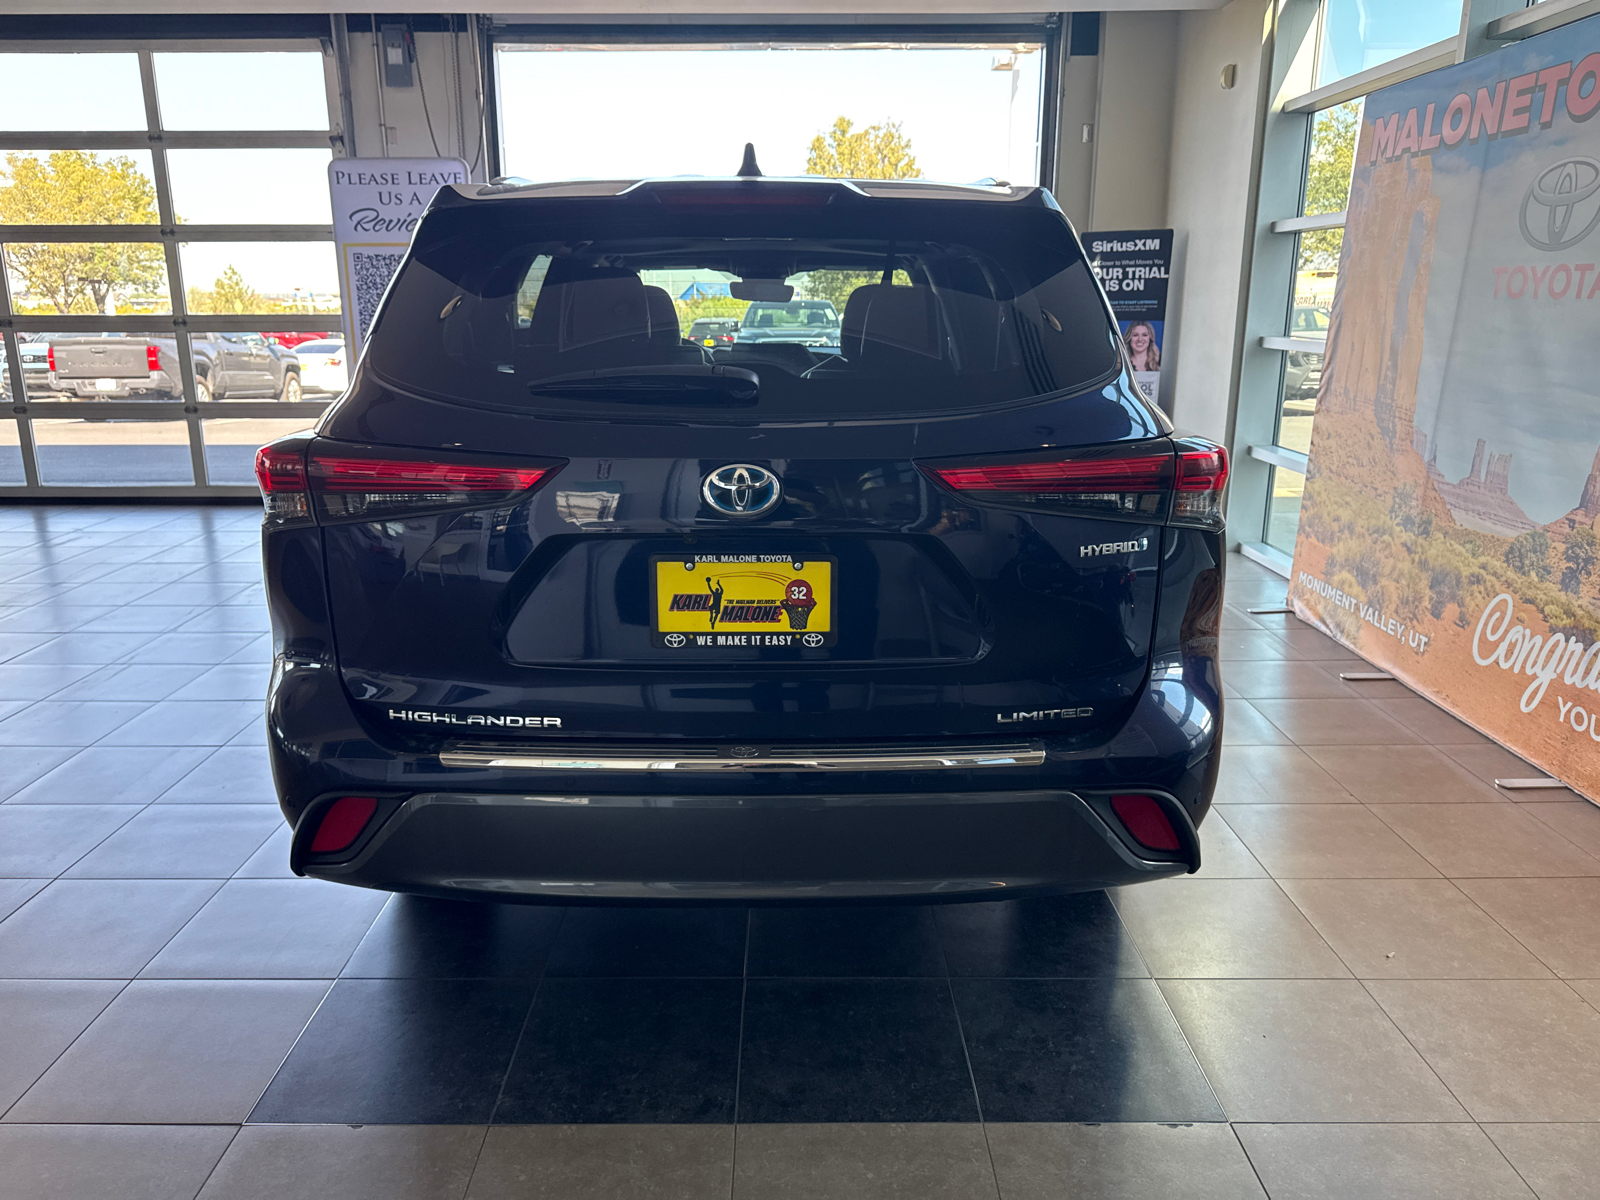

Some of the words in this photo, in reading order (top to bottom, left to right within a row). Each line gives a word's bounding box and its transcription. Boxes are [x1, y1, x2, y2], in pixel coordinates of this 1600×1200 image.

[334, 170, 400, 185] PLEASE
[406, 170, 463, 185] LEAVE
[377, 191, 403, 205] US
[408, 191, 423, 205] A
[348, 207, 419, 233] Revie
[1092, 239, 1160, 252] SiriusXM
[1093, 267, 1123, 280] OUR
[1126, 266, 1169, 279] TRIAL
[1105, 280, 1119, 292] IS
[1122, 279, 1144, 291] ON
[1080, 541, 1140, 557] HYBRID
[694, 555, 720, 563] KARL
[760, 554, 792, 562] TOYOTA
[790, 586, 807, 600] 32
[669, 594, 712, 612] KARL
[718, 604, 783, 623] MALONE
[1299, 570, 1358, 613] MONUMENT
[1358, 603, 1406, 645] VALLEY,
[1408, 632, 1429, 653] UT
[696, 635, 713, 646] WE
[717, 635, 748, 646] MAKE
[752, 635, 761, 646] IT
[765, 635, 792, 646] EASY
[1472, 593, 1600, 713] Congra
[389, 709, 562, 728] HIGHLANDER
[997, 707, 1094, 723] LIMITED
